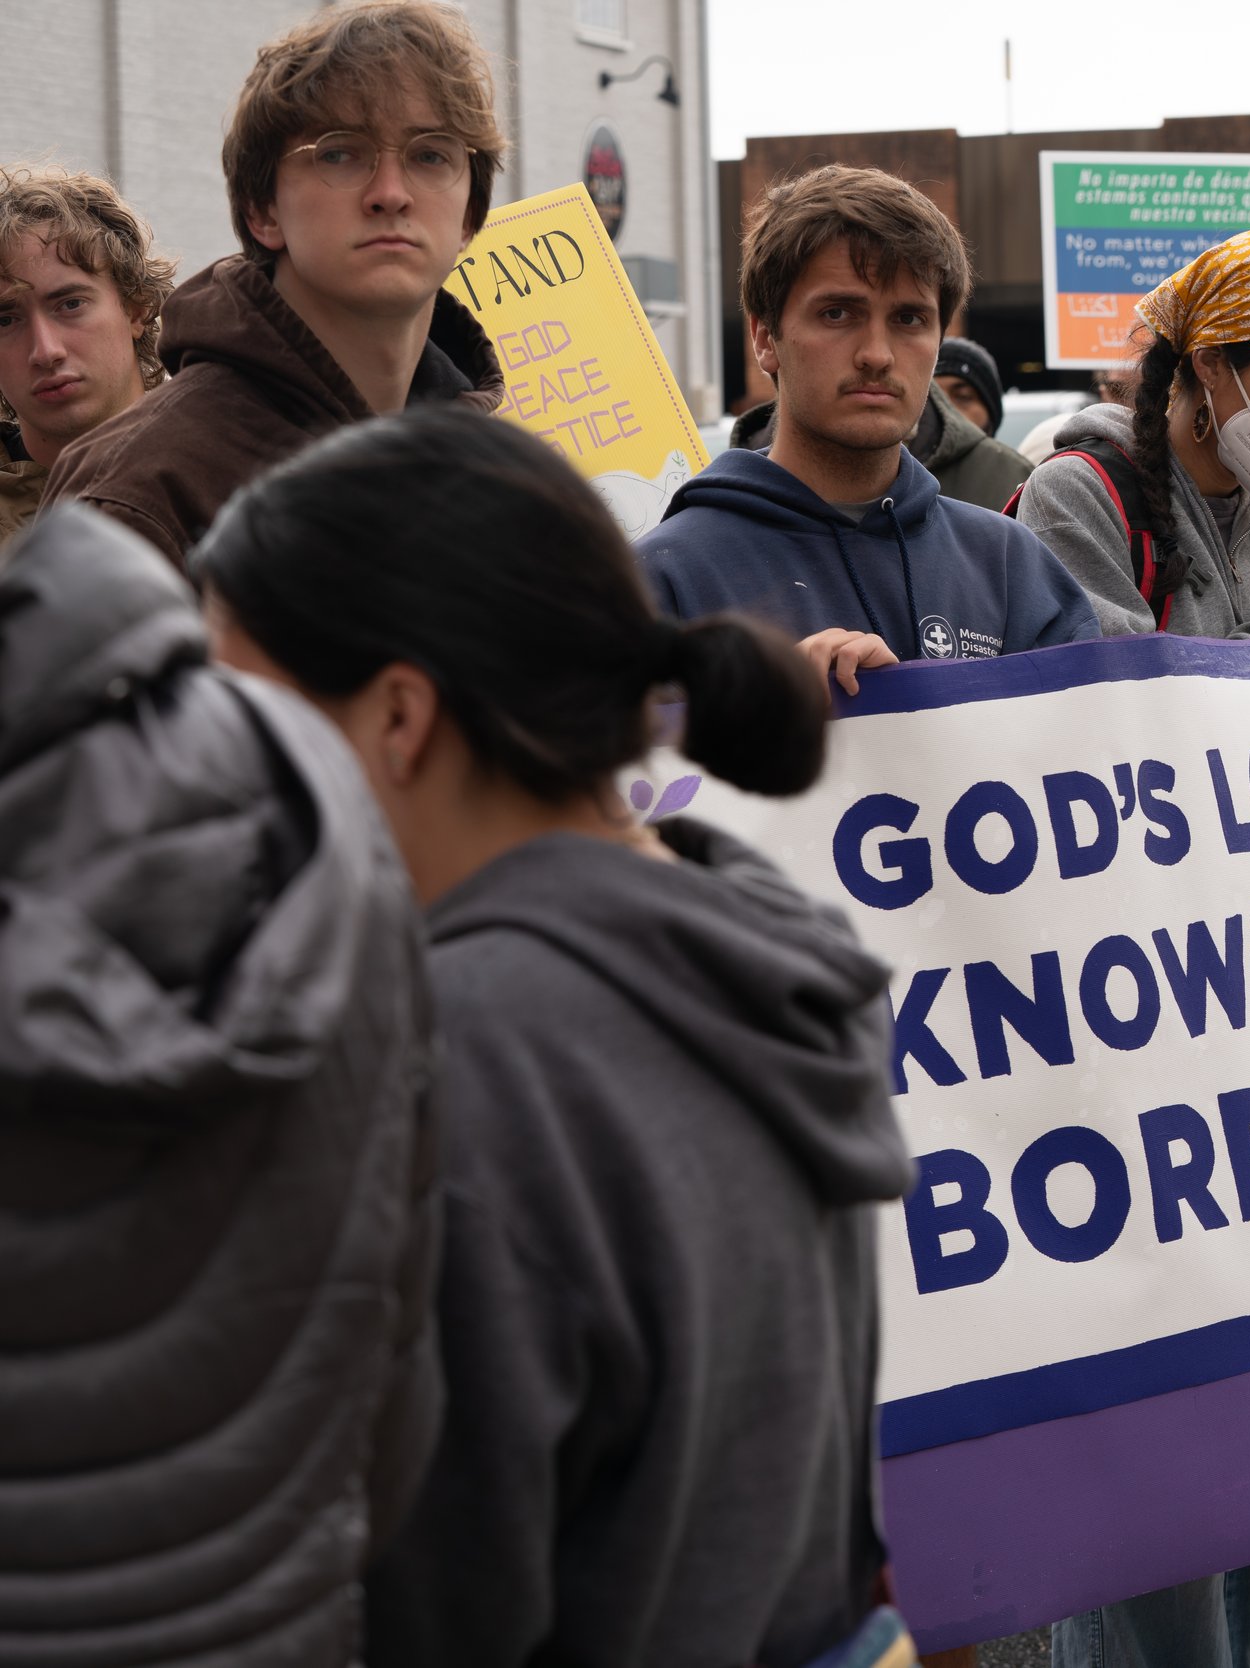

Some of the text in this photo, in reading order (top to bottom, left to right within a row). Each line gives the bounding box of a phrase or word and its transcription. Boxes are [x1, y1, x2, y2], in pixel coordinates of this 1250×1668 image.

[1079, 169, 1102, 187] No
[1108, 171, 1177, 190] importa
[1183, 170, 1205, 189] de
[1075, 187, 1146, 206] estamos
[1152, 189, 1236, 207] contentos
[1130, 205, 1197, 222] nuestro
[1066, 234, 1097, 250] No
[1104, 234, 1173, 251] matter
[1076, 251, 1132, 270] from,
[496, 320, 572, 371] GOD
[961, 640, 999, 658] Disaster
[833, 759, 1191, 911] GOD'S
